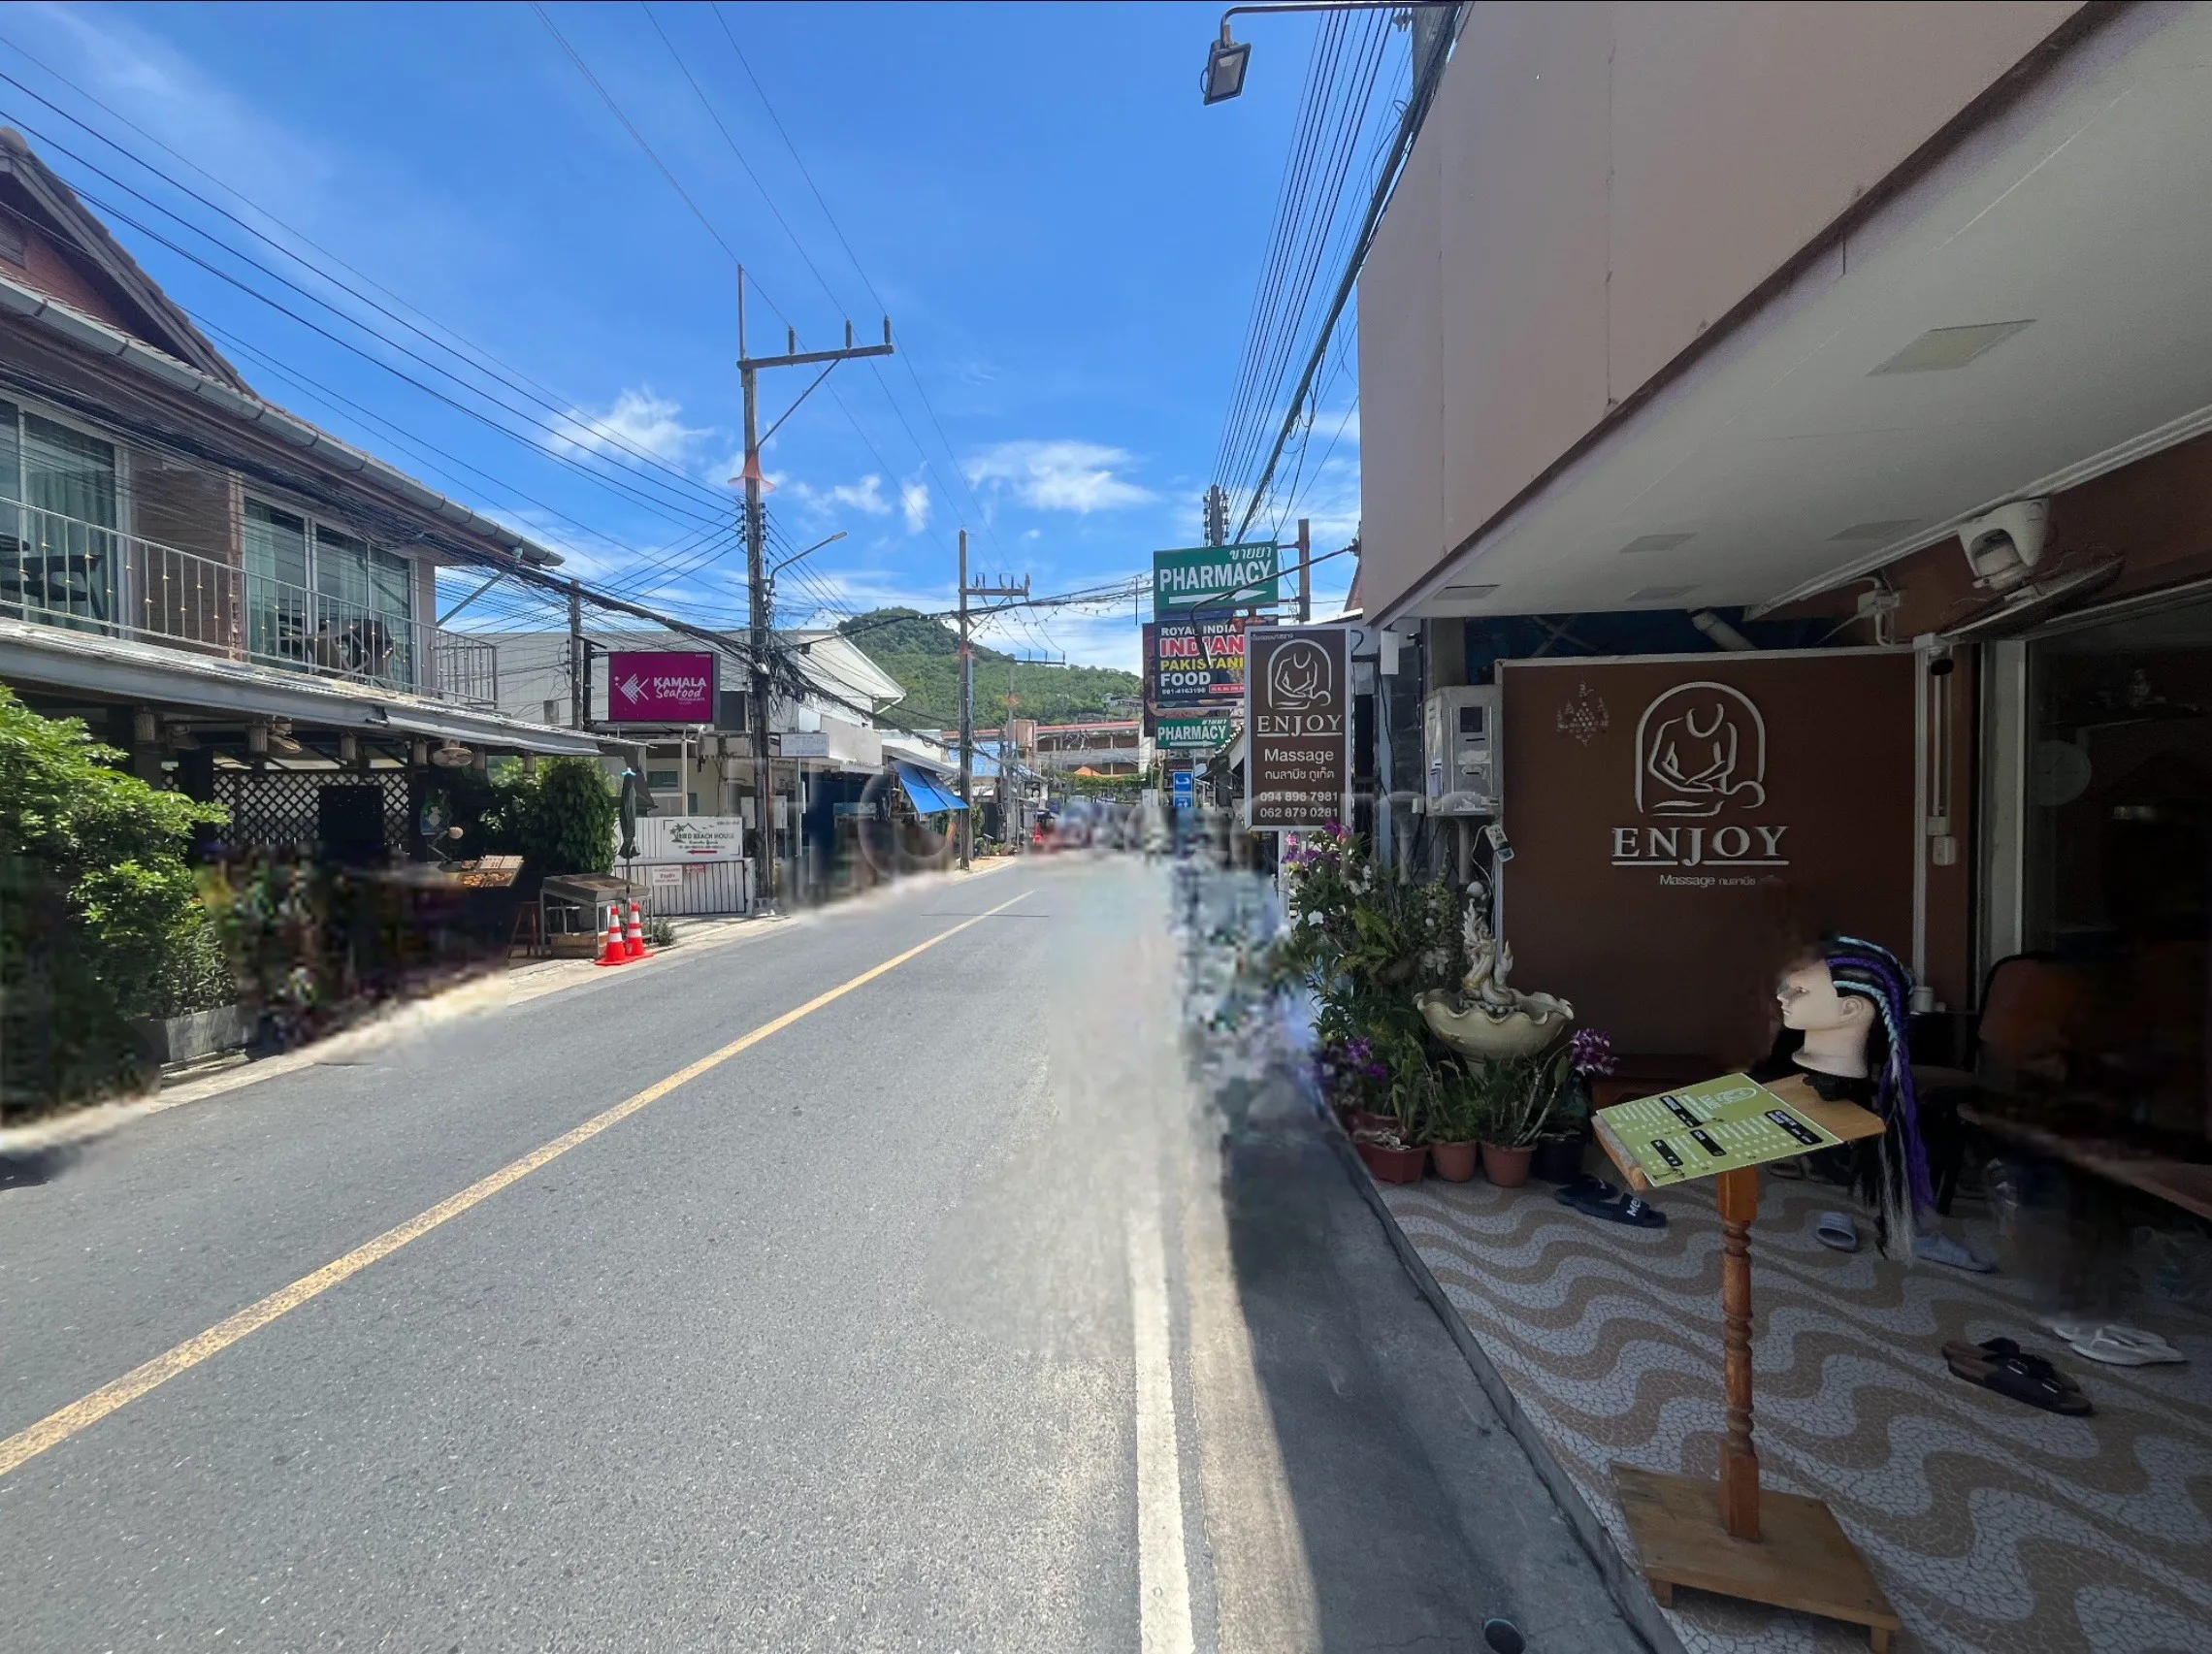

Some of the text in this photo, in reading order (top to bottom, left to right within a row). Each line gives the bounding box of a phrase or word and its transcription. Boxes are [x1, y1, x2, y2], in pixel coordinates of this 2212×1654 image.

[1229, 546, 1272, 560] ขายยา
[1159, 560, 1272, 592] PHARMACY
[1203, 624, 1237, 634] INDIA
[1160, 657, 1245, 671] PAKISTANI
[653, 676, 706, 687] KAMALA
[1160, 671, 1211, 687] FOOD
[656, 684, 703, 698] Seafood
[1256, 714, 1343, 736] ENJOY
[1157, 725, 1226, 740] PHARMACY
[1264, 748, 1334, 764] Massage
[1259, 792, 1282, 802] 094
[1310, 792, 1338, 802] 7981
[1259, 807, 1338, 818] 062 879 0281
[1611, 826, 1790, 867] ENJOY
[1660, 874, 1715, 889] Massage
